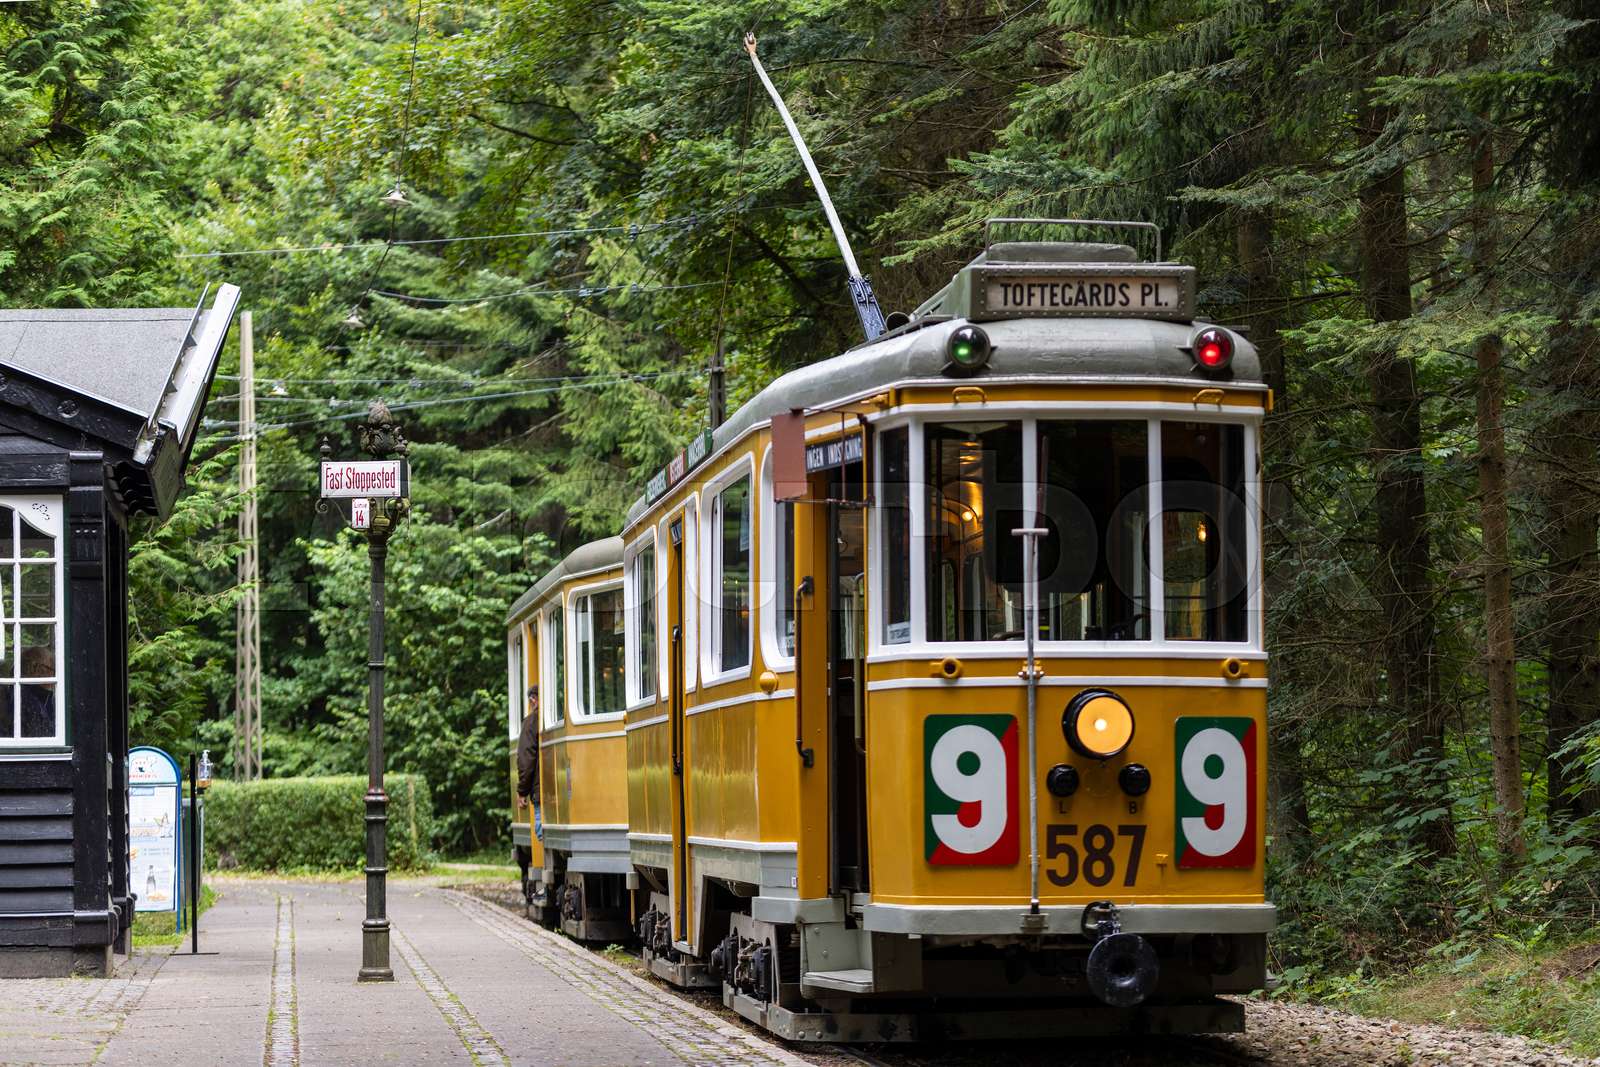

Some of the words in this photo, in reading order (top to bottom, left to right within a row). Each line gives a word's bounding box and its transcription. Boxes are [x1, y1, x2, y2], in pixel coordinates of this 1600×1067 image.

[1000, 280, 1130, 307] TOFTEGÅRDS
[1140, 283, 1169, 307] PL.
[325, 467, 343, 490] Fast
[345, 466, 396, 492] Stoppested
[355, 510, 365, 526] 14
[930, 724, 1008, 854] 9
[1181, 727, 1248, 857] 9
[1059, 801, 1068, 814] L
[1128, 801, 1138, 815] B
[1046, 824, 1148, 888] 587
